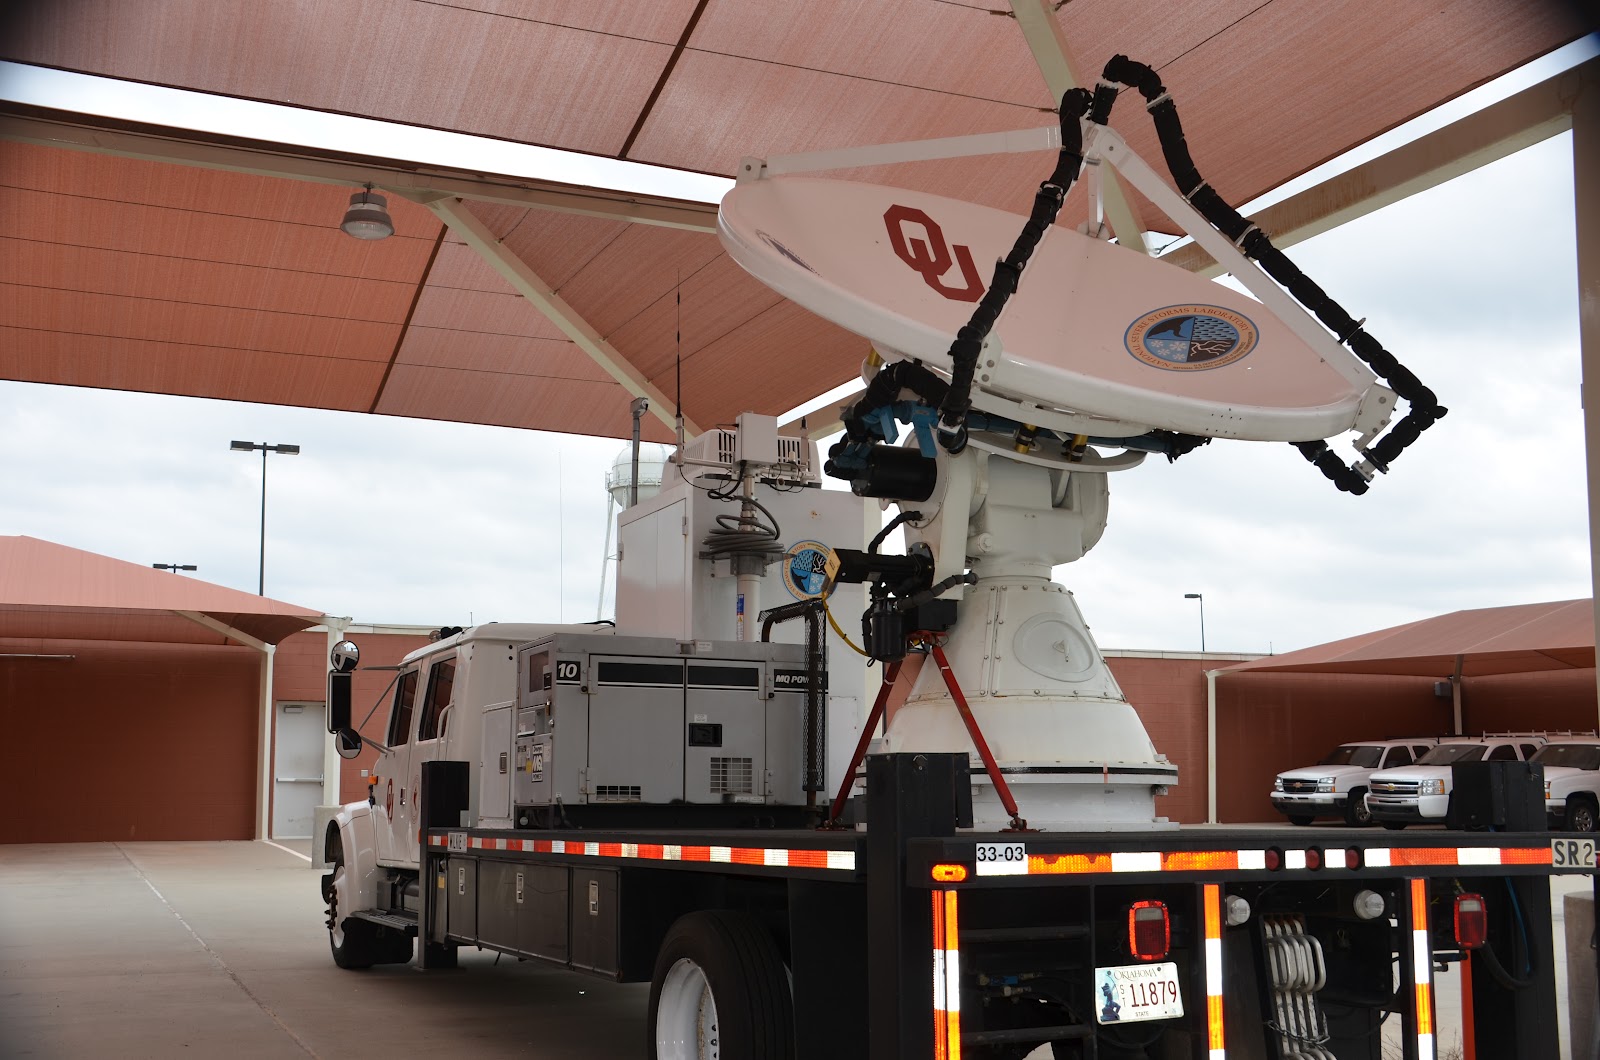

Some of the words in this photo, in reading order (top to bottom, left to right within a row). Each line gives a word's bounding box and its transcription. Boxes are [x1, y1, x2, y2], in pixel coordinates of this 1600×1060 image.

[883, 204, 985, 303] OU
[1148, 307, 1190, 322] STORMS
[1193, 307, 1250, 331] LABORATORY
[1130, 319, 1149, 343] SEVERE
[1132, 345, 1171, 368] NATIONAL
[558, 663, 578, 678] 10
[775, 674, 791, 684] MQ
[977, 846, 1024, 861] 33-03
[1113, 968, 1158, 981] OKLAHOMA
[1129, 980, 1177, 1008] 11879
